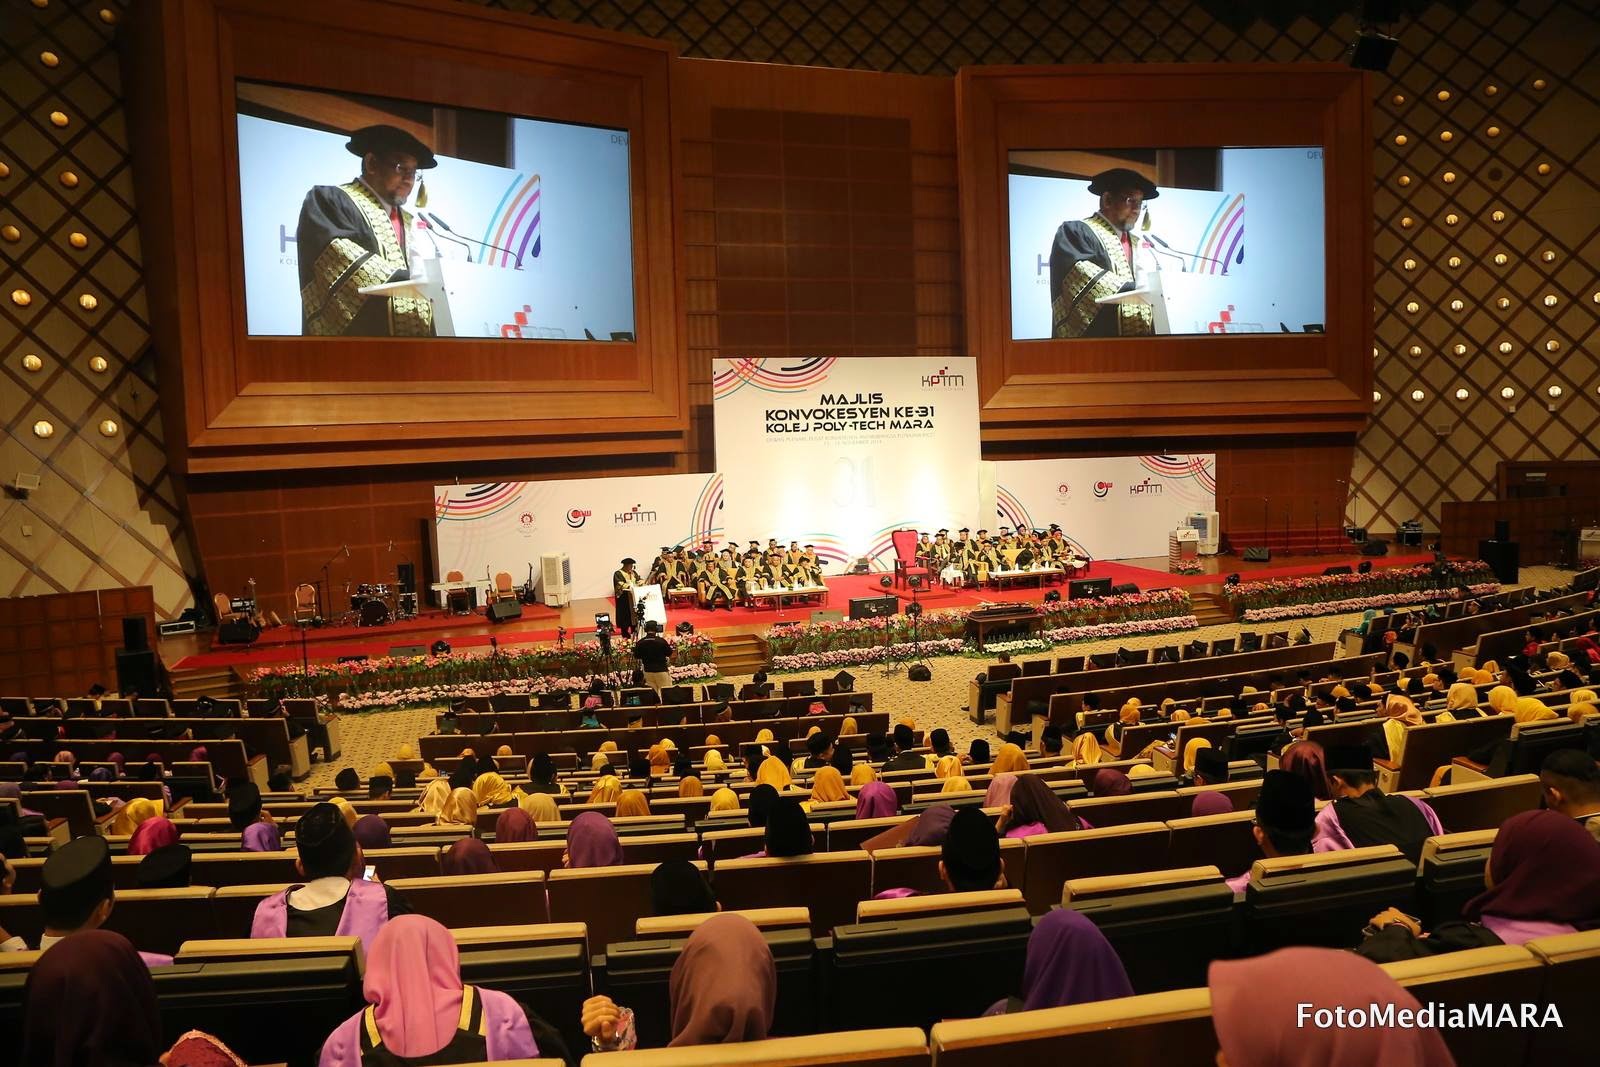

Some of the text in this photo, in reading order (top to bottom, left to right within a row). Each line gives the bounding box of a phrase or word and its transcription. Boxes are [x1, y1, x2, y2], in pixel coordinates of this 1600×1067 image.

[819, 392, 884, 406] MAJLIS
[765, 406, 935, 421] KONVOKESYEN KE-31
[765, 419, 935, 434] KOLEJ POLY-TECH MARA
